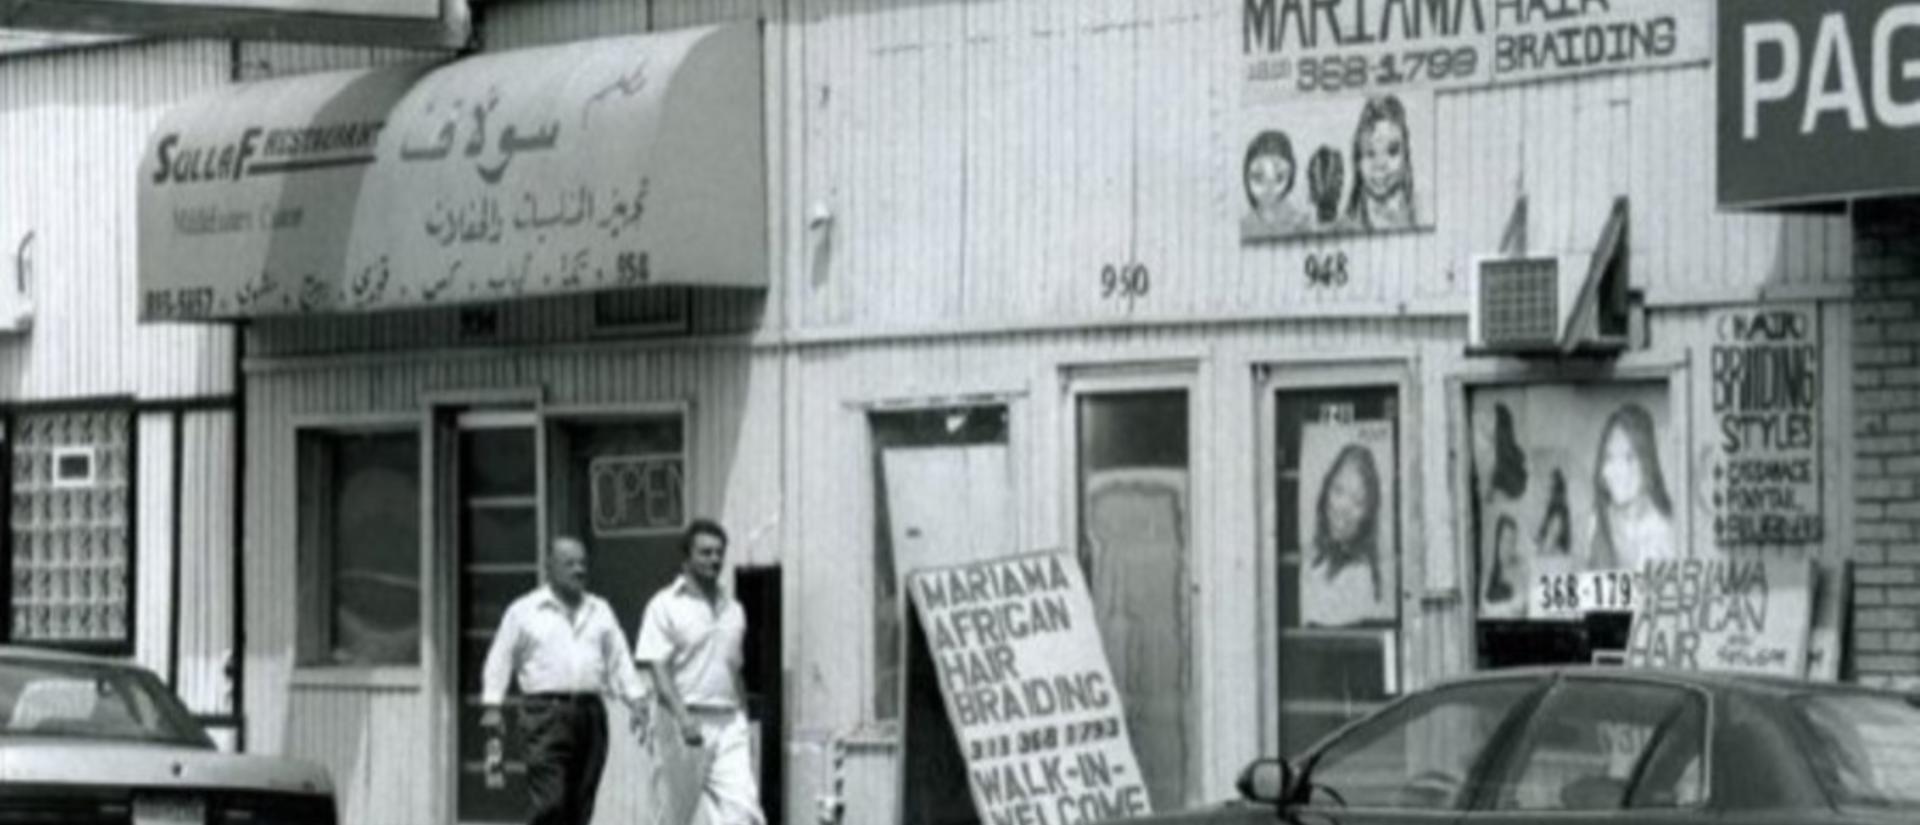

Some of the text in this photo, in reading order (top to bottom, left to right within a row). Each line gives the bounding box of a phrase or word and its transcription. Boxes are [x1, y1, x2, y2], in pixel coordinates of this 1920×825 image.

[1243, 0, 1486, 53] MARIAMA
[1496, 17, 1677, 73] BRAIDING
[1100, 263, 1149, 299] 950
[1304, 250, 1349, 289] 948
[1722, 413, 1813, 453] STYLES
[596, 460, 683, 526] OPEN
[919, 556, 1070, 610] MARIAMA
[1540, 571, 1641, 611] 368-179
[934, 595, 1072, 650] AFRICAN
[940, 645, 1020, 692] HAIR
[954, 670, 1111, 727] BRAIDING
